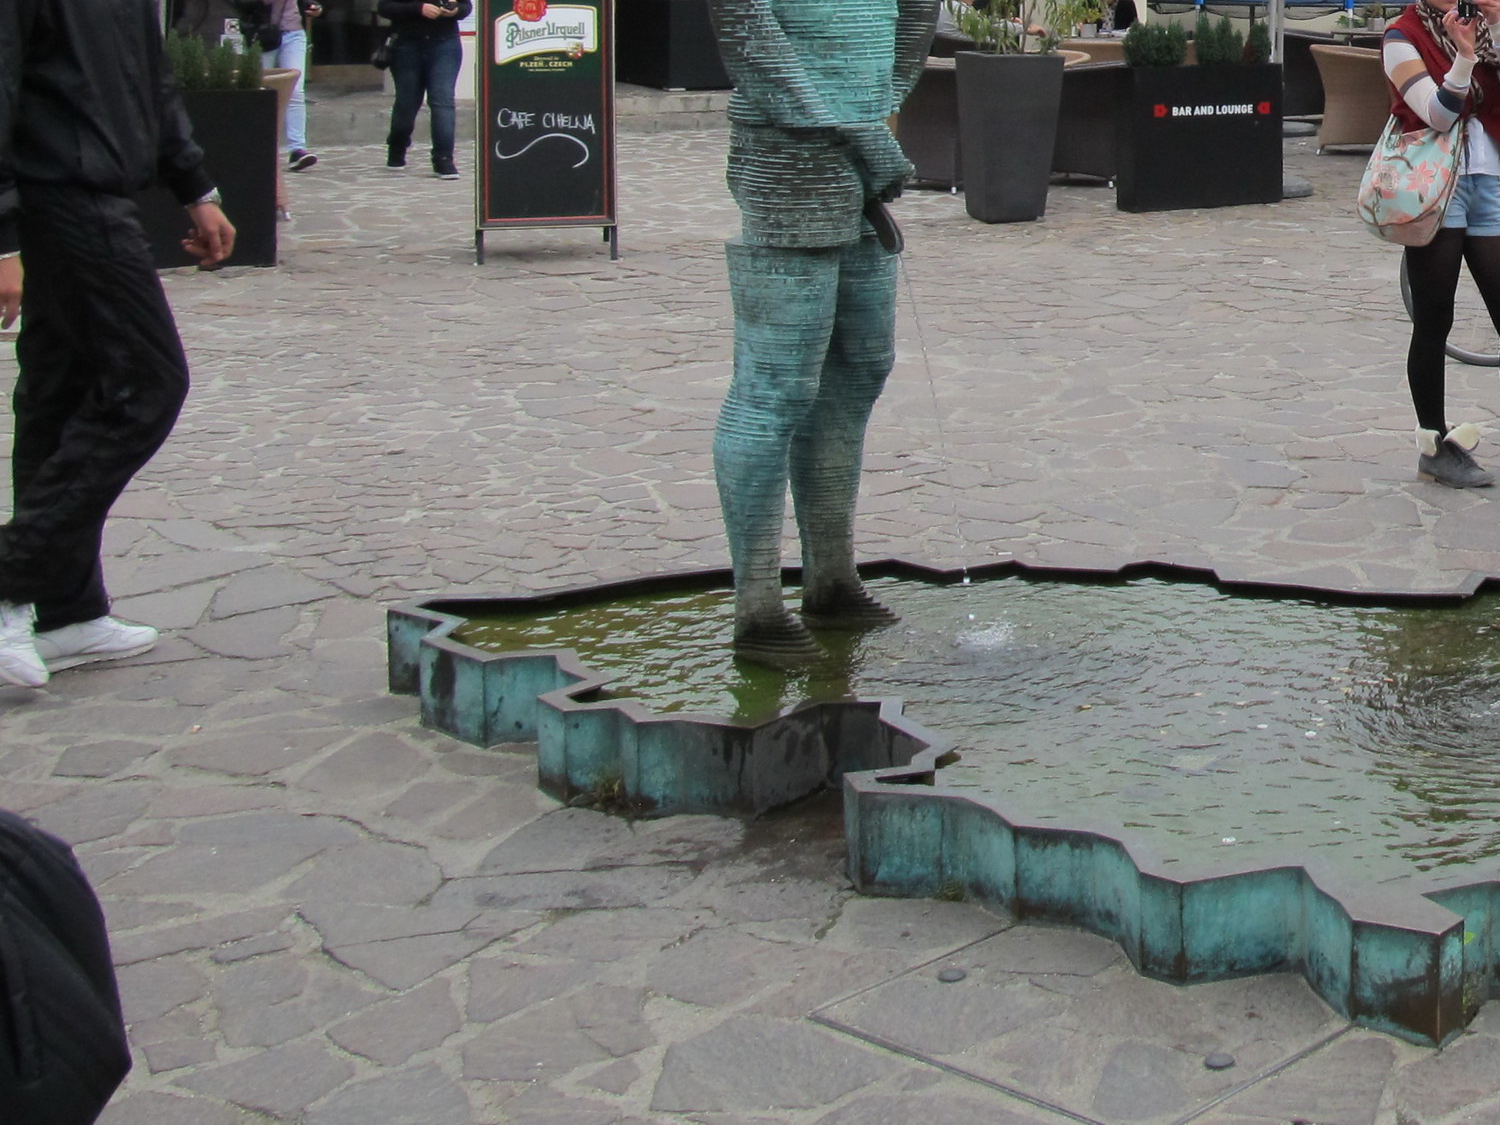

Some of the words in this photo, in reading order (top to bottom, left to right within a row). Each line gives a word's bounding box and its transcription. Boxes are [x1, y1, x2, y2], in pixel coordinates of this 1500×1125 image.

[505, 22, 547, 49] Pilsner
[545, 21, 586, 41] Urquell
[497, 107, 536, 130] CAFE
[1172, 106, 1192, 116] BAR
[1193, 105, 1214, 115] AND
[1215, 104, 1253, 115] LOUNGE
